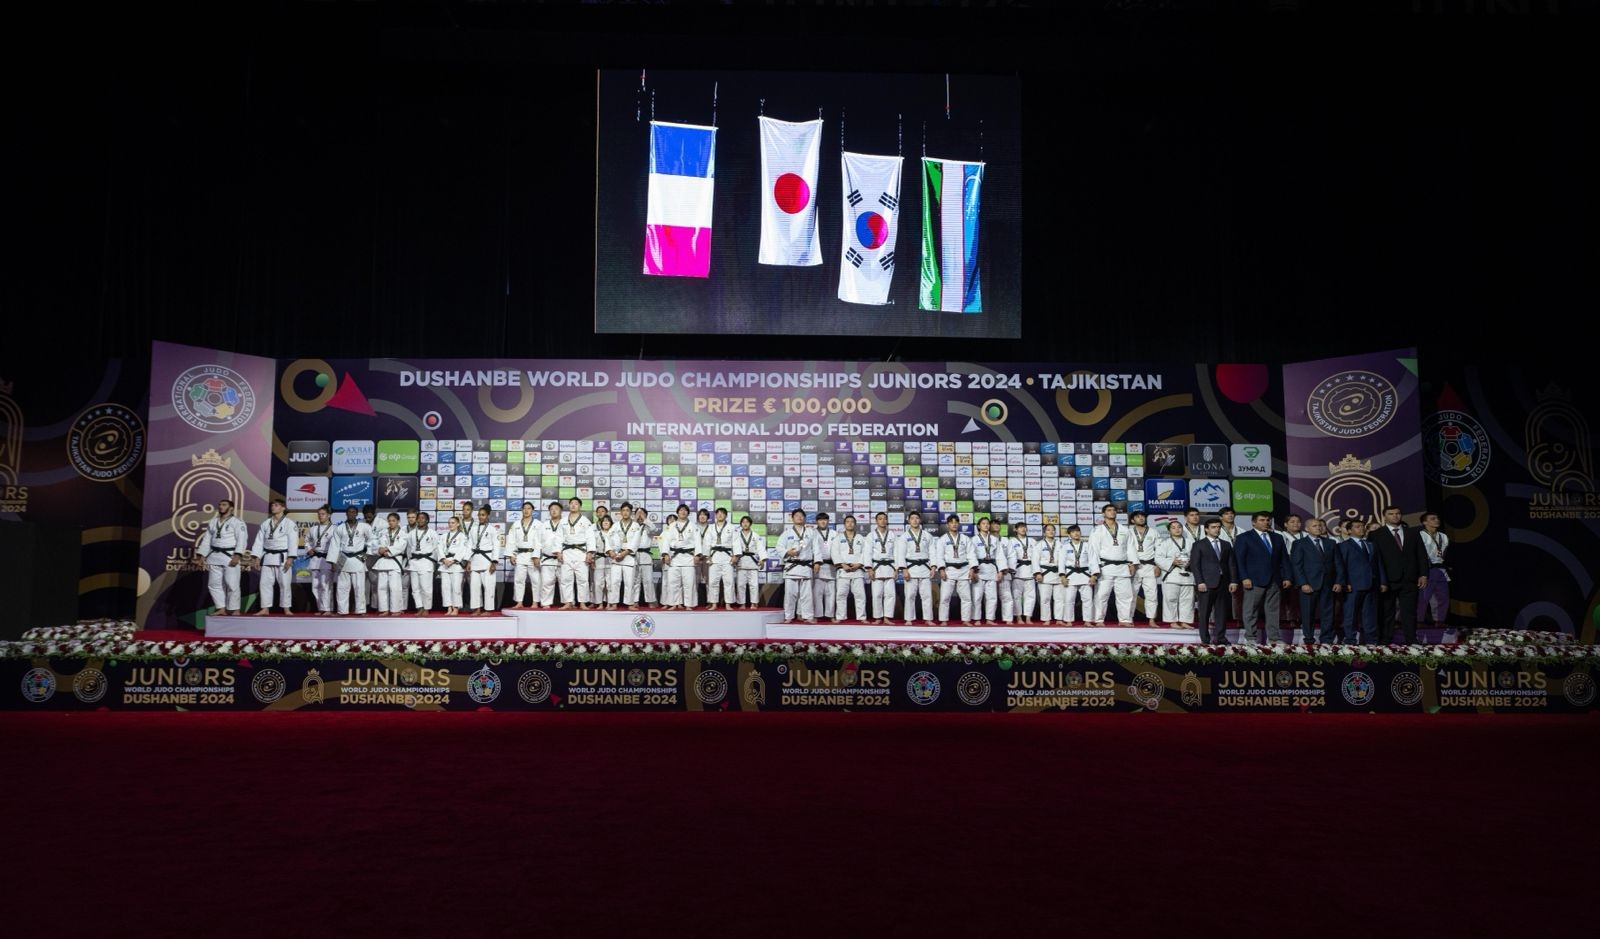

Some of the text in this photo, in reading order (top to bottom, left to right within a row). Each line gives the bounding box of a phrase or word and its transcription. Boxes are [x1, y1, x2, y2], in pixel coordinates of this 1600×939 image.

[203, 367, 230, 376] JUDO
[400, 370, 1163, 390] DUSHANBE WORLD JUDO CHAMPIONSHIPS JUNIORS 2024 TAJIKISTAN
[174, 373, 208, 428] INTERNATIONAL
[232, 381, 253, 427] FEDERATION
[694, 397, 872, 416] PRIZE € 100,000
[1312, 402, 1338, 432] TAJIKISTAN
[1364, 394, 1392, 432] FEDERATION
[627, 422, 939, 436] INTERNATIONAL JUDO FEDERATION
[1192, 462, 1225, 471] ICONA
[342, 498, 369, 506] MET
[124, 694, 235, 704] DUSHANBE 2024
[340, 694, 450, 704] DUSHANBE 2024
[568, 694, 678, 704] DUSHANBE 2024
[782, 695, 890, 705] DUSHANBE 2024
[1007, 696, 1115, 706] DUSHANBE 2024
[1218, 696, 1326, 706] DUSHANBE 2024
[1440, 696, 1547, 706] DUSHANBE 2024
